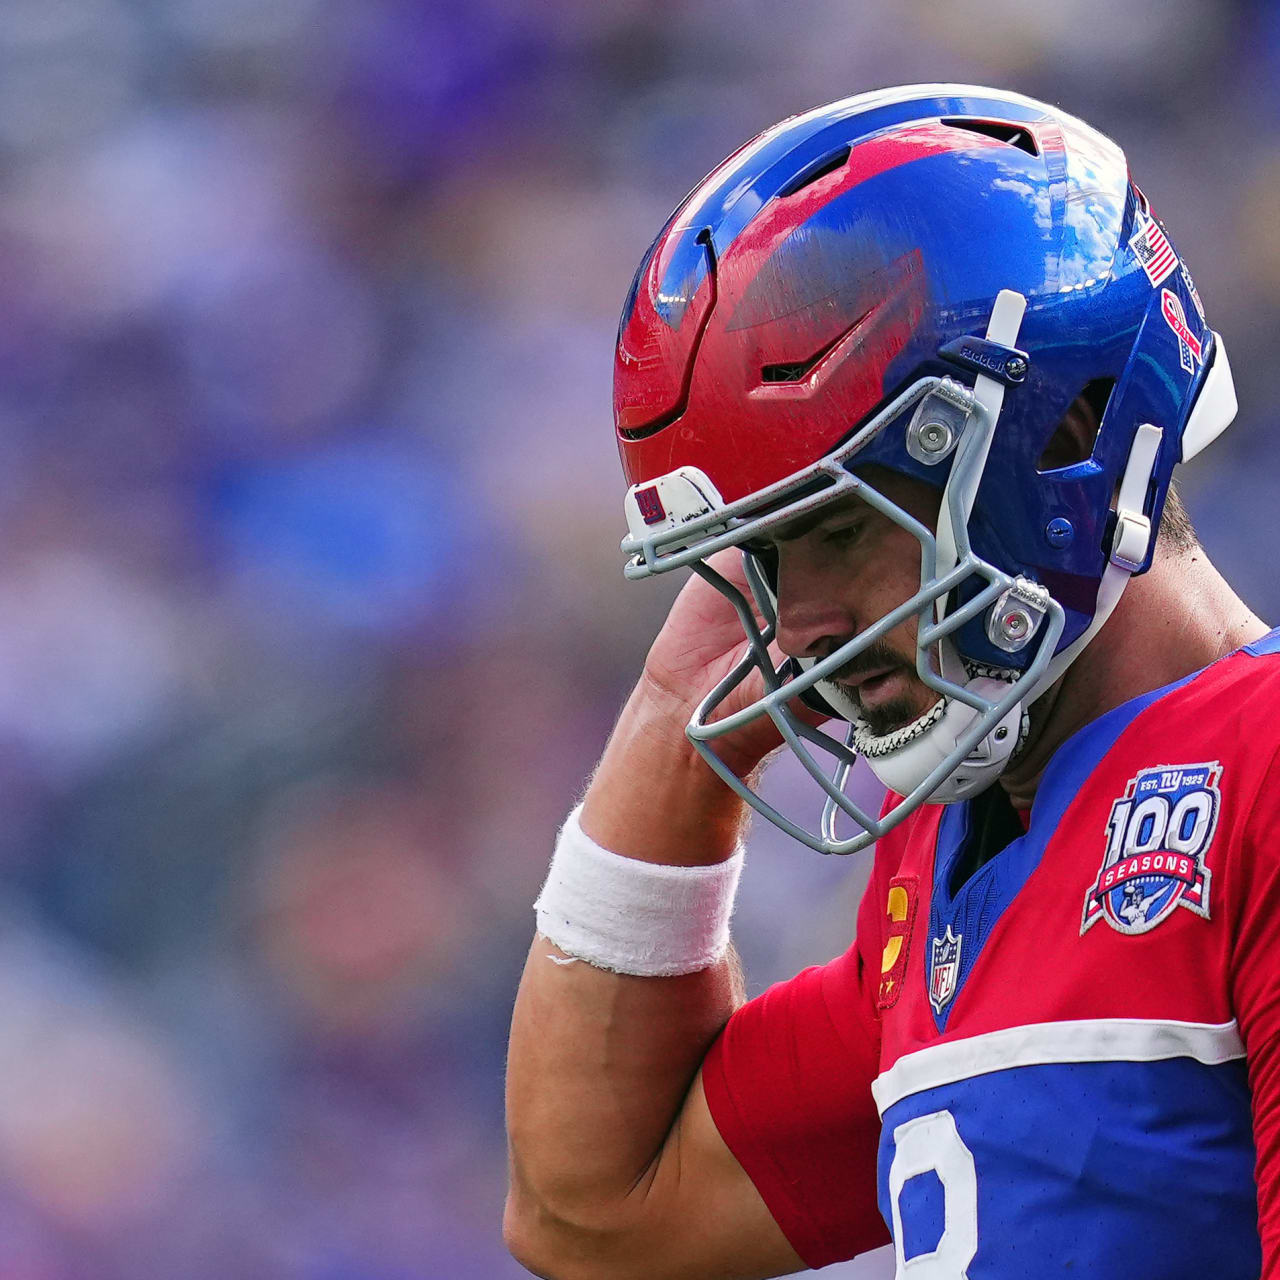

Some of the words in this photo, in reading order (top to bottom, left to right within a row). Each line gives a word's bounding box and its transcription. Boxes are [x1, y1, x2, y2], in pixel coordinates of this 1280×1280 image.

[1174, 320, 1190, 342] 9/11
[1140, 779, 1158, 792] EST.
[1182, 774, 1205, 786] 1925
[1107, 791, 1214, 867] 100
[1105, 855, 1189, 886] SEASONS
[932, 965, 952, 998] NFL
